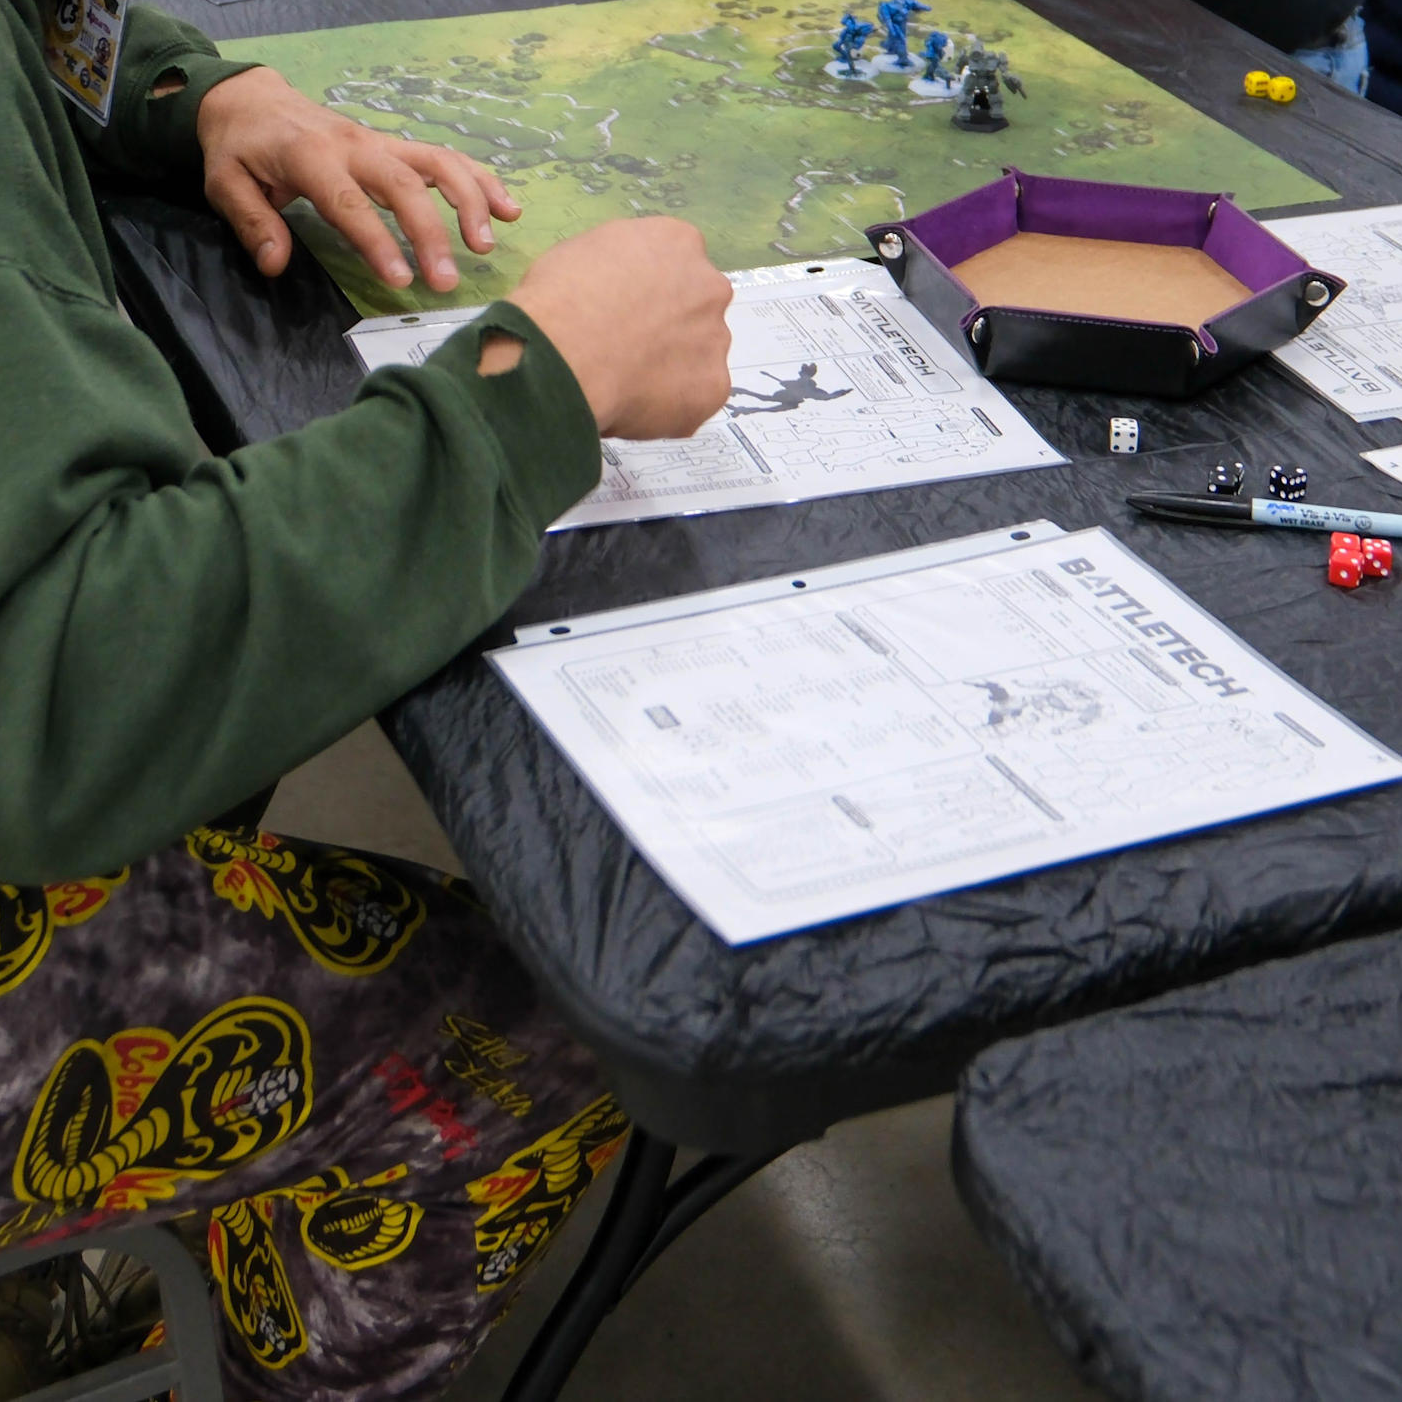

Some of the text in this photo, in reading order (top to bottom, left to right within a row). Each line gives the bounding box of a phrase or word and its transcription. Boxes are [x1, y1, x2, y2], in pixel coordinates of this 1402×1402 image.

[852, 290, 936, 376] BATTLETECH
[1296, 335, 1382, 393] BATTLET
[1058, 557, 1249, 698] BATTLETECH
[113, 1036, 171, 1120] Cobra
